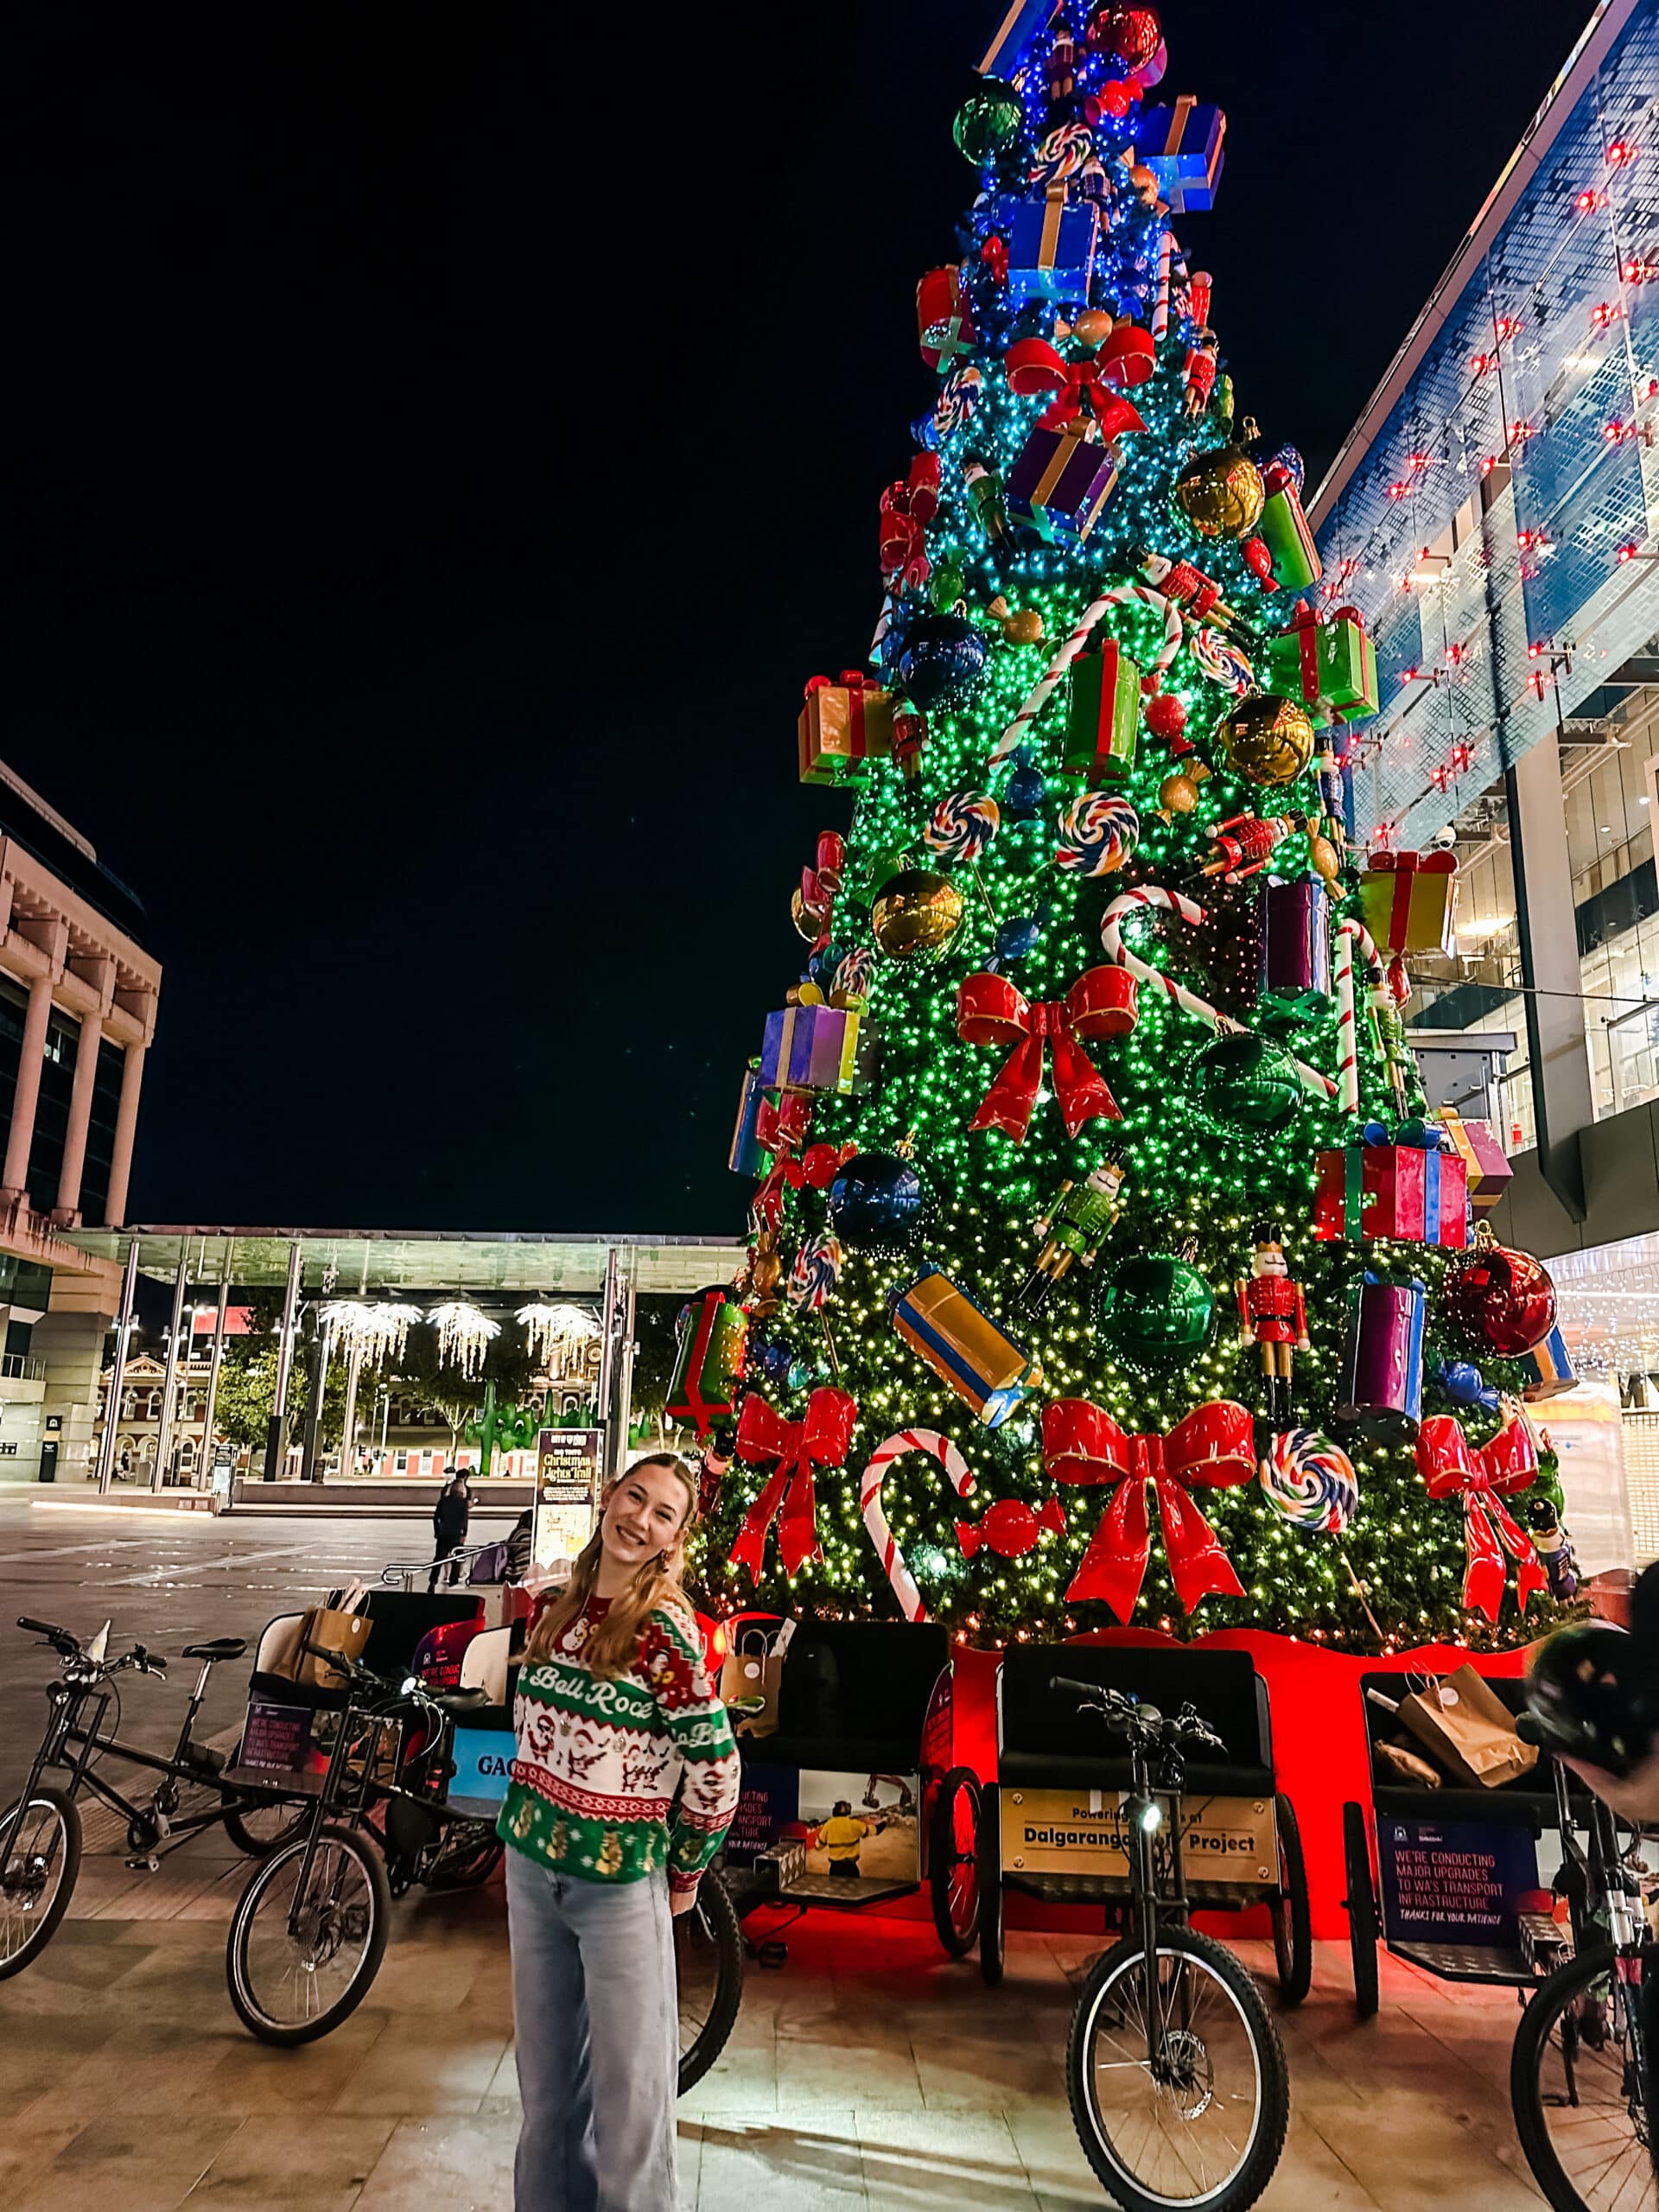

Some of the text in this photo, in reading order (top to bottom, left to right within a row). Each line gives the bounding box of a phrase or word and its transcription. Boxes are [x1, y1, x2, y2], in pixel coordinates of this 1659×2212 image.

[543, 1453, 591, 1469] Christmas
[542, 1465, 592, 1483] Lights Trail
[529, 1665, 586, 1700] Bell
[1189, 1833, 1255, 1853] Project
[1395, 1849, 1496, 1868] WE'RE CONDUCTING
[1395, 1865, 1489, 1881] MAJOR UPGRADES
[1398, 1878, 1503, 1897] TO WA'S TRANSPORT
[1398, 1893, 1490, 1910] INFRASTRUCTURE
[1400, 1908, 1502, 1925] THANKS FOR YOUR PATIENCE
